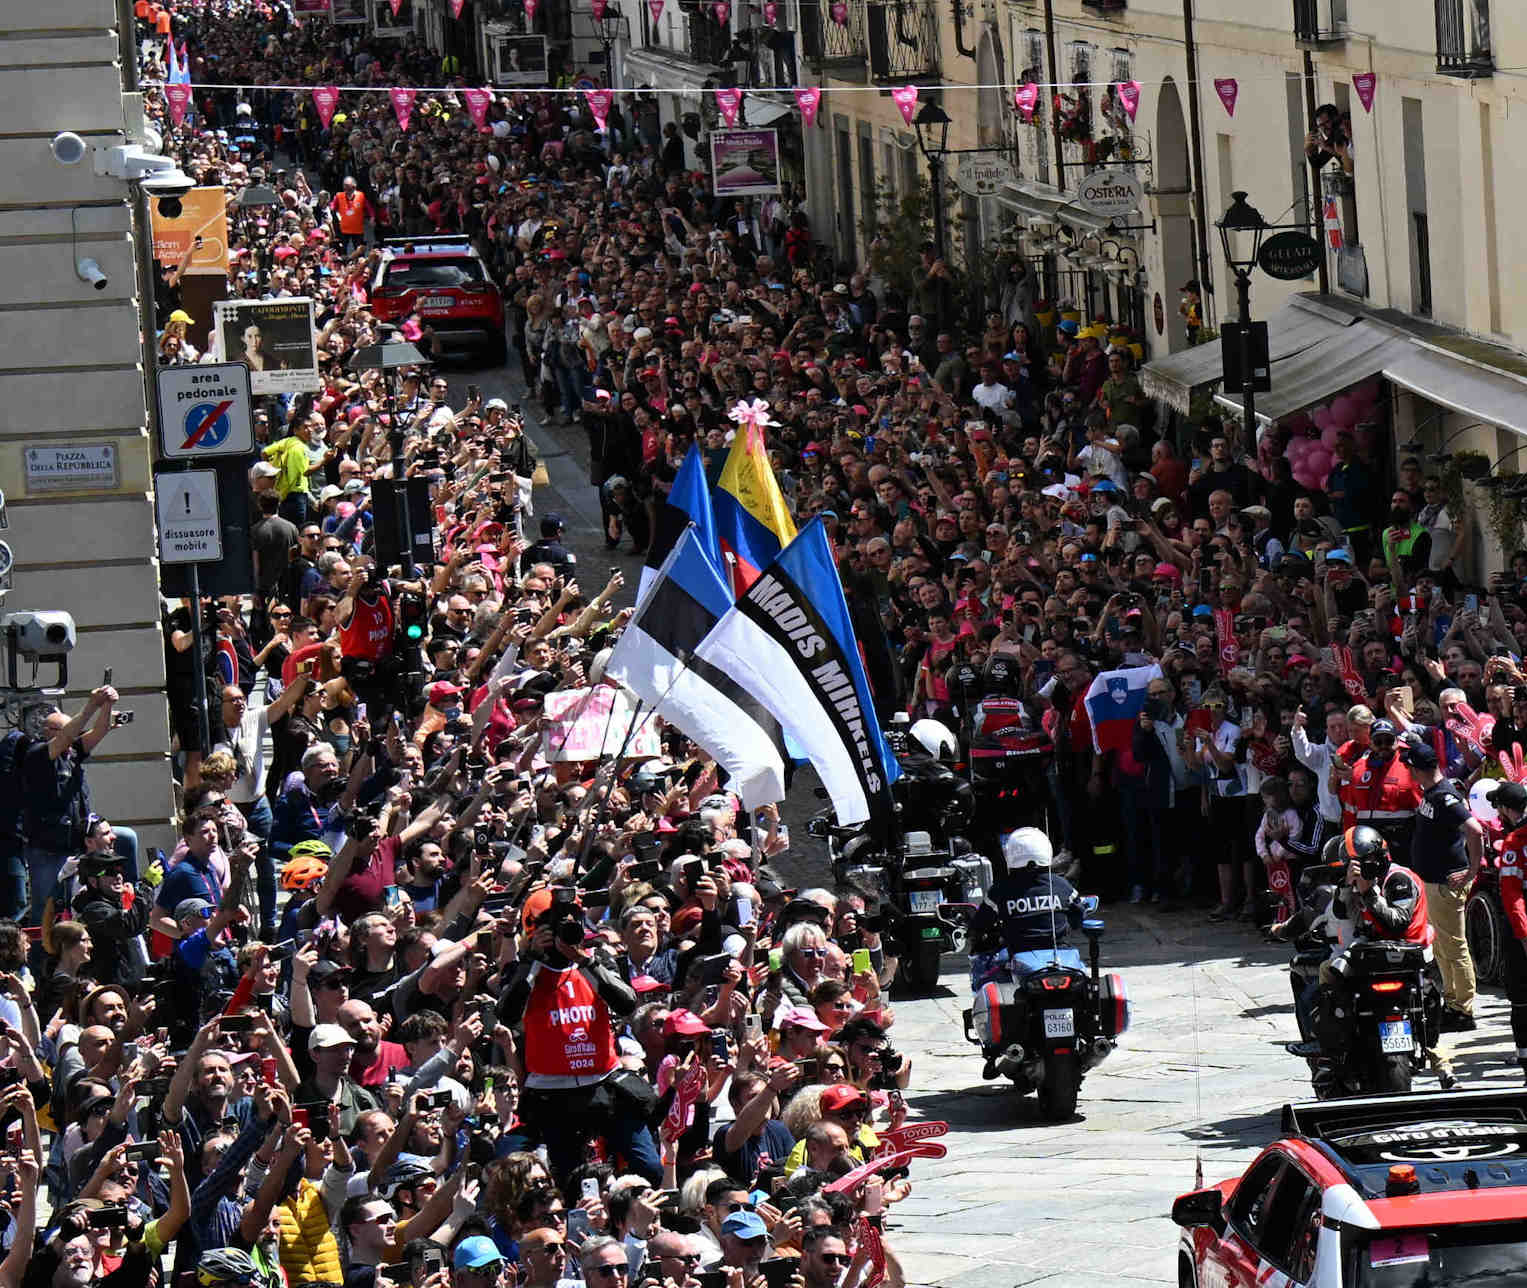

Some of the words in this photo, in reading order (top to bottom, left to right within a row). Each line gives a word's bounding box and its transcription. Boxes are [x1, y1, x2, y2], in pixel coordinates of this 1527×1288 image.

[1083, 186, 1136, 200] OSTERIA
[191, 373, 220, 384] area
[177, 387, 238, 401] pedonale
[55, 452, 86, 461] PIAZZA
[56, 460, 112, 471] REPUBBLICA
[164, 528, 215, 540] dissuasore
[174, 540, 207, 552] mobile
[747, 573, 827, 659] MADIS
[811, 659, 882, 795] MIHKELS
[1006, 895, 1063, 914] POLIZIA
[549, 1005, 597, 1025] PHOTO
[569, 1059, 594, 1070] 2024
[902, 1126, 943, 1140] TOYOTA
[1372, 1129, 1429, 1144] Giro
[1432, 1124, 1518, 1139] d'Italia
